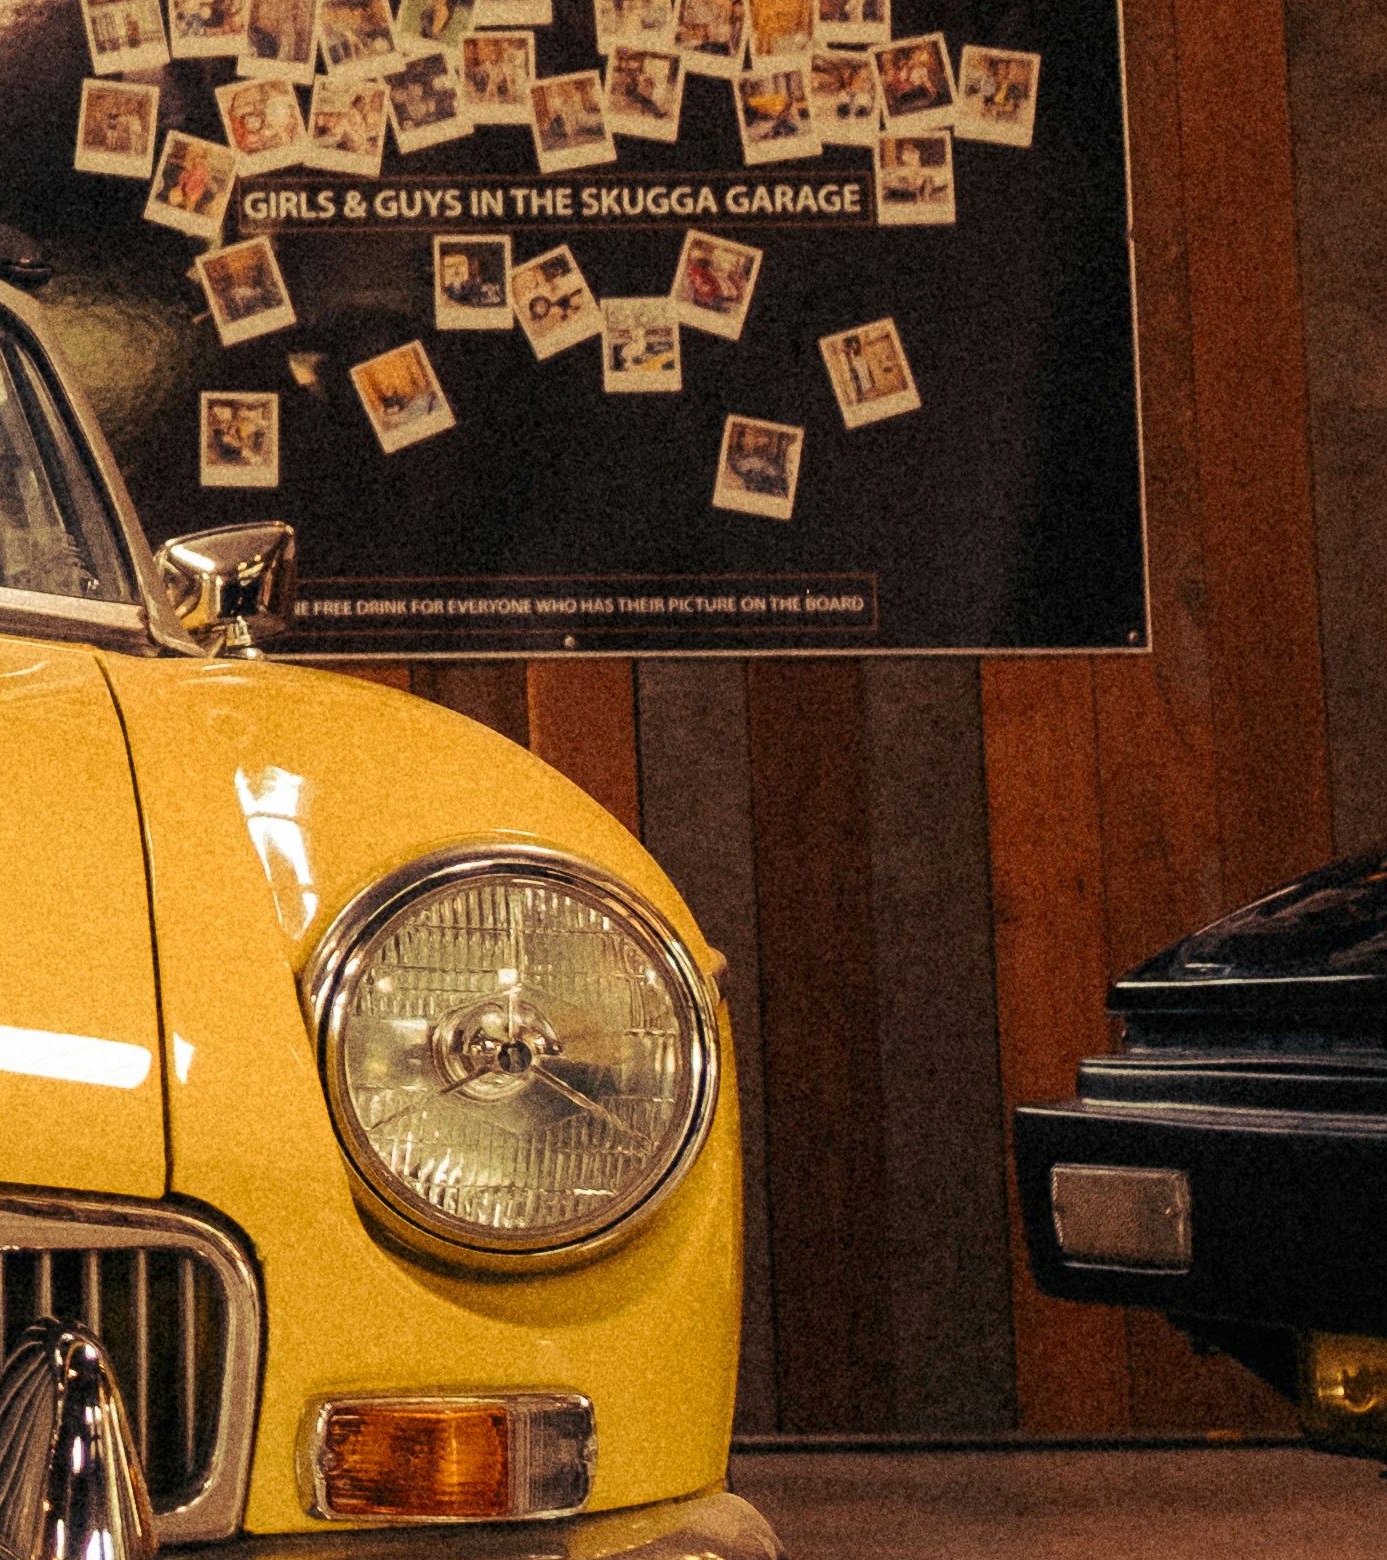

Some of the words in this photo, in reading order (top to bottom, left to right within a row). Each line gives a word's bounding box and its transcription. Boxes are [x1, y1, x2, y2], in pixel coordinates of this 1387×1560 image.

[244, 189, 337, 219] GIRLS
[343, 189, 367, 218] &
[374, 188, 463, 218] GUYS
[470, 188, 505, 217] IN
[510, 186, 573, 217] THE
[581, 185, 718, 216] SKUGGA
[725, 184, 862, 213] GARAGE
[313, 599, 352, 616] FREE
[356, 599, 407, 616] DRINK
[411, 599, 444, 615] FOR
[448, 598, 532, 615] EVERYONE
[536, 597, 577, 614] WHO
[581, 596, 615, 613] HAS
[618, 596, 665, 613] THEIR
[669, 596, 737, 612] PICTURE
[740, 596, 767, 612] ON
[770, 596, 802, 612] THE
[805, 595, 865, 611] BOARD
